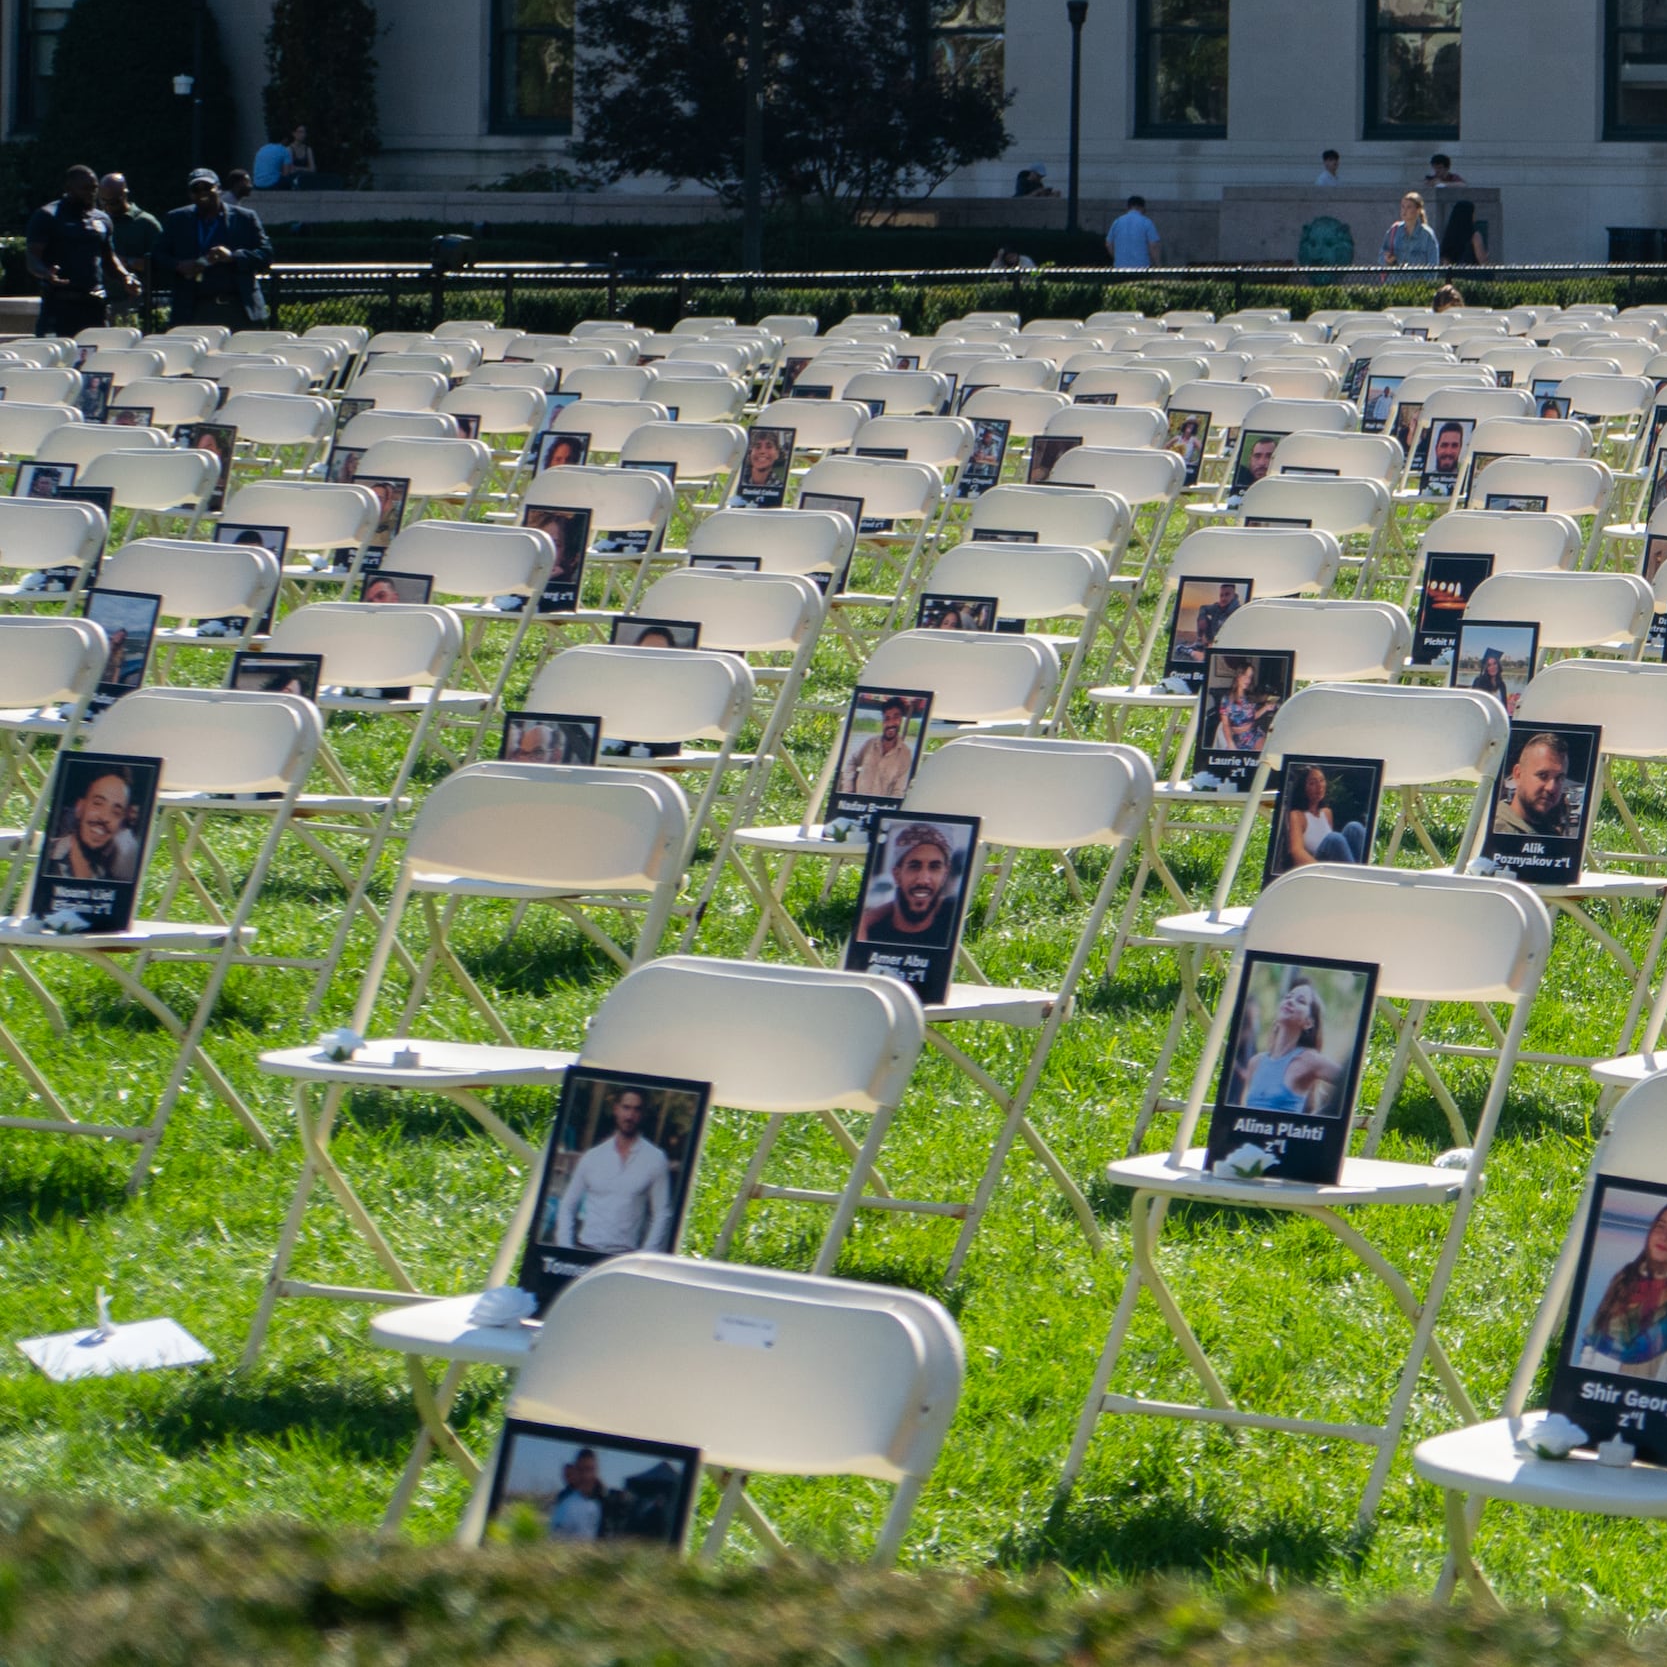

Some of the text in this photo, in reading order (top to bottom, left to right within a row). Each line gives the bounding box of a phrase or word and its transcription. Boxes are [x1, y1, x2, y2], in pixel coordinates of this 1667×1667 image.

[1209, 755, 1241, 767] Laurie
[1232, 767, 1246, 778] z"l
[1522, 842, 1545, 855] Alik
[1493, 853, 1570, 870] Poznyakov z"l
[1232, 1117, 1325, 1142] Alina Plahti
[1264, 1138, 1287, 1155] z"l
[1580, 1382, 1622, 1405] Shir
[1617, 1410, 1646, 1431] z"l
